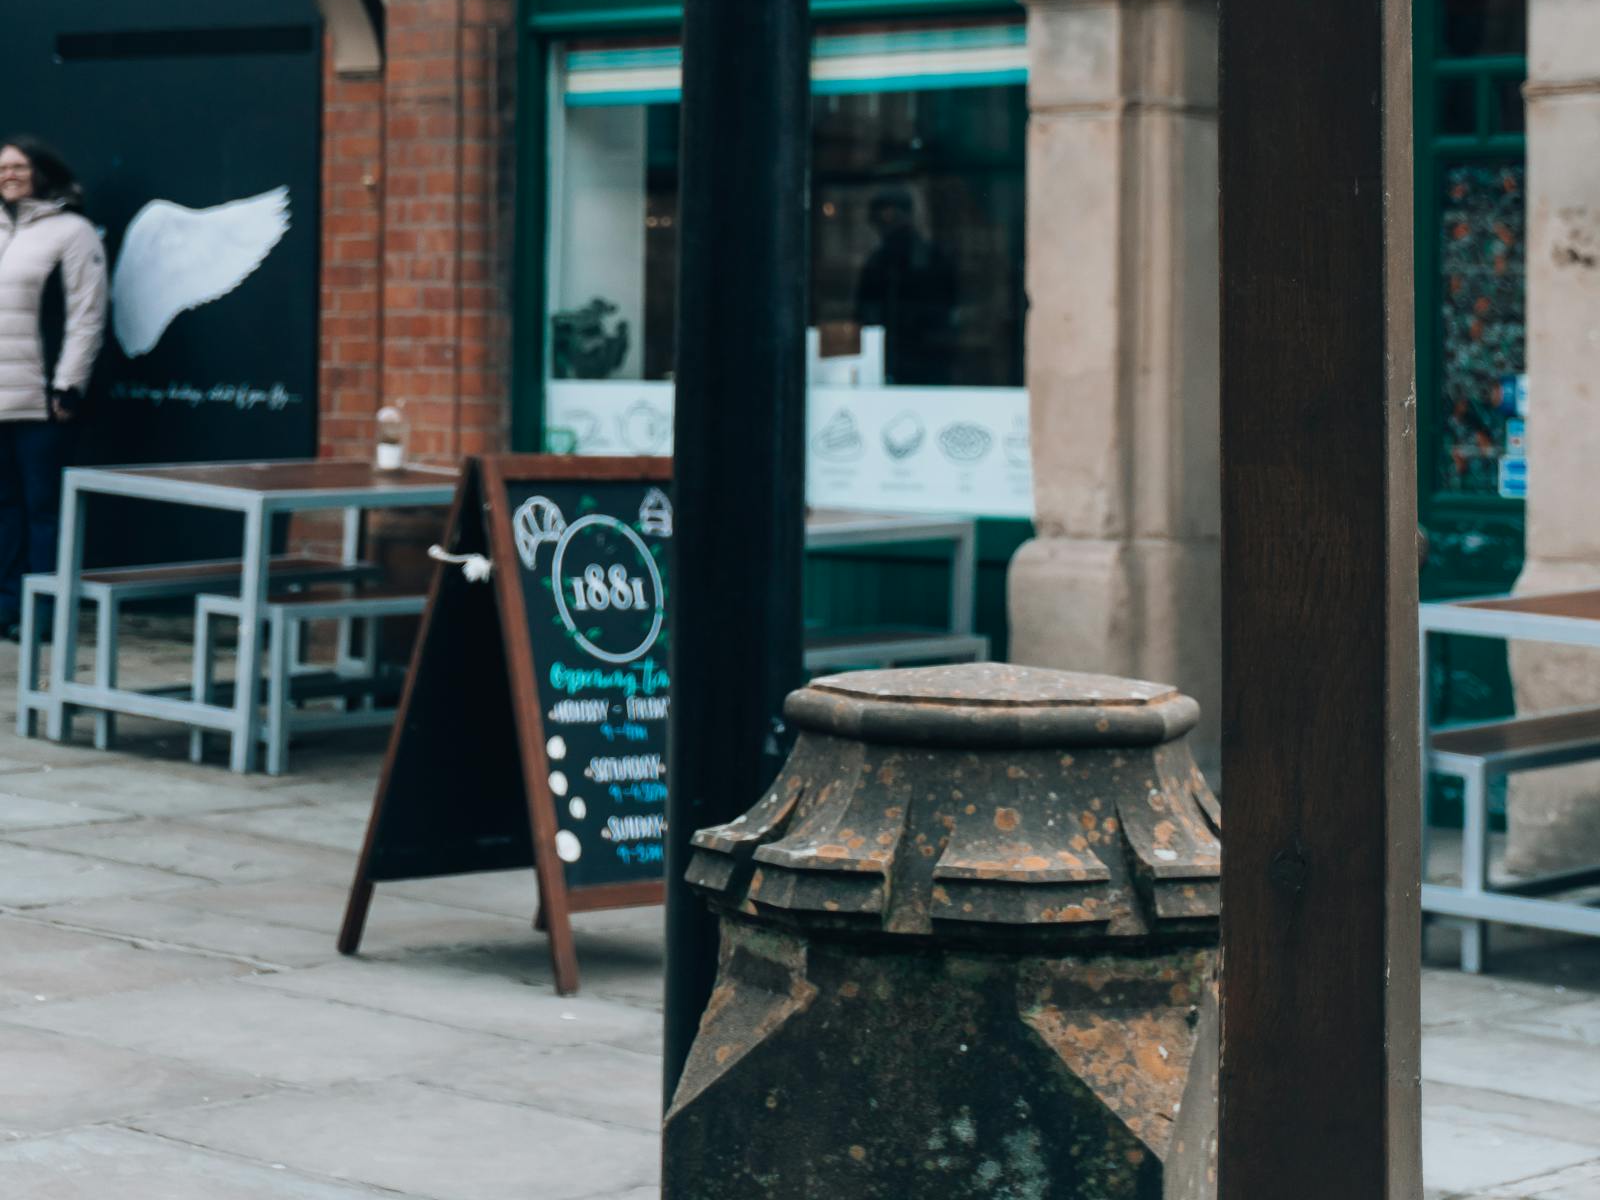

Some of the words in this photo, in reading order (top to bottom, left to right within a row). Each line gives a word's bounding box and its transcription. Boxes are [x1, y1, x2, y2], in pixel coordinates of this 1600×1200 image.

[571, 563, 649, 611] 1881
[590, 753, 661, 782] SATURDAY
[607, 813, 663, 842] SUNDAY
